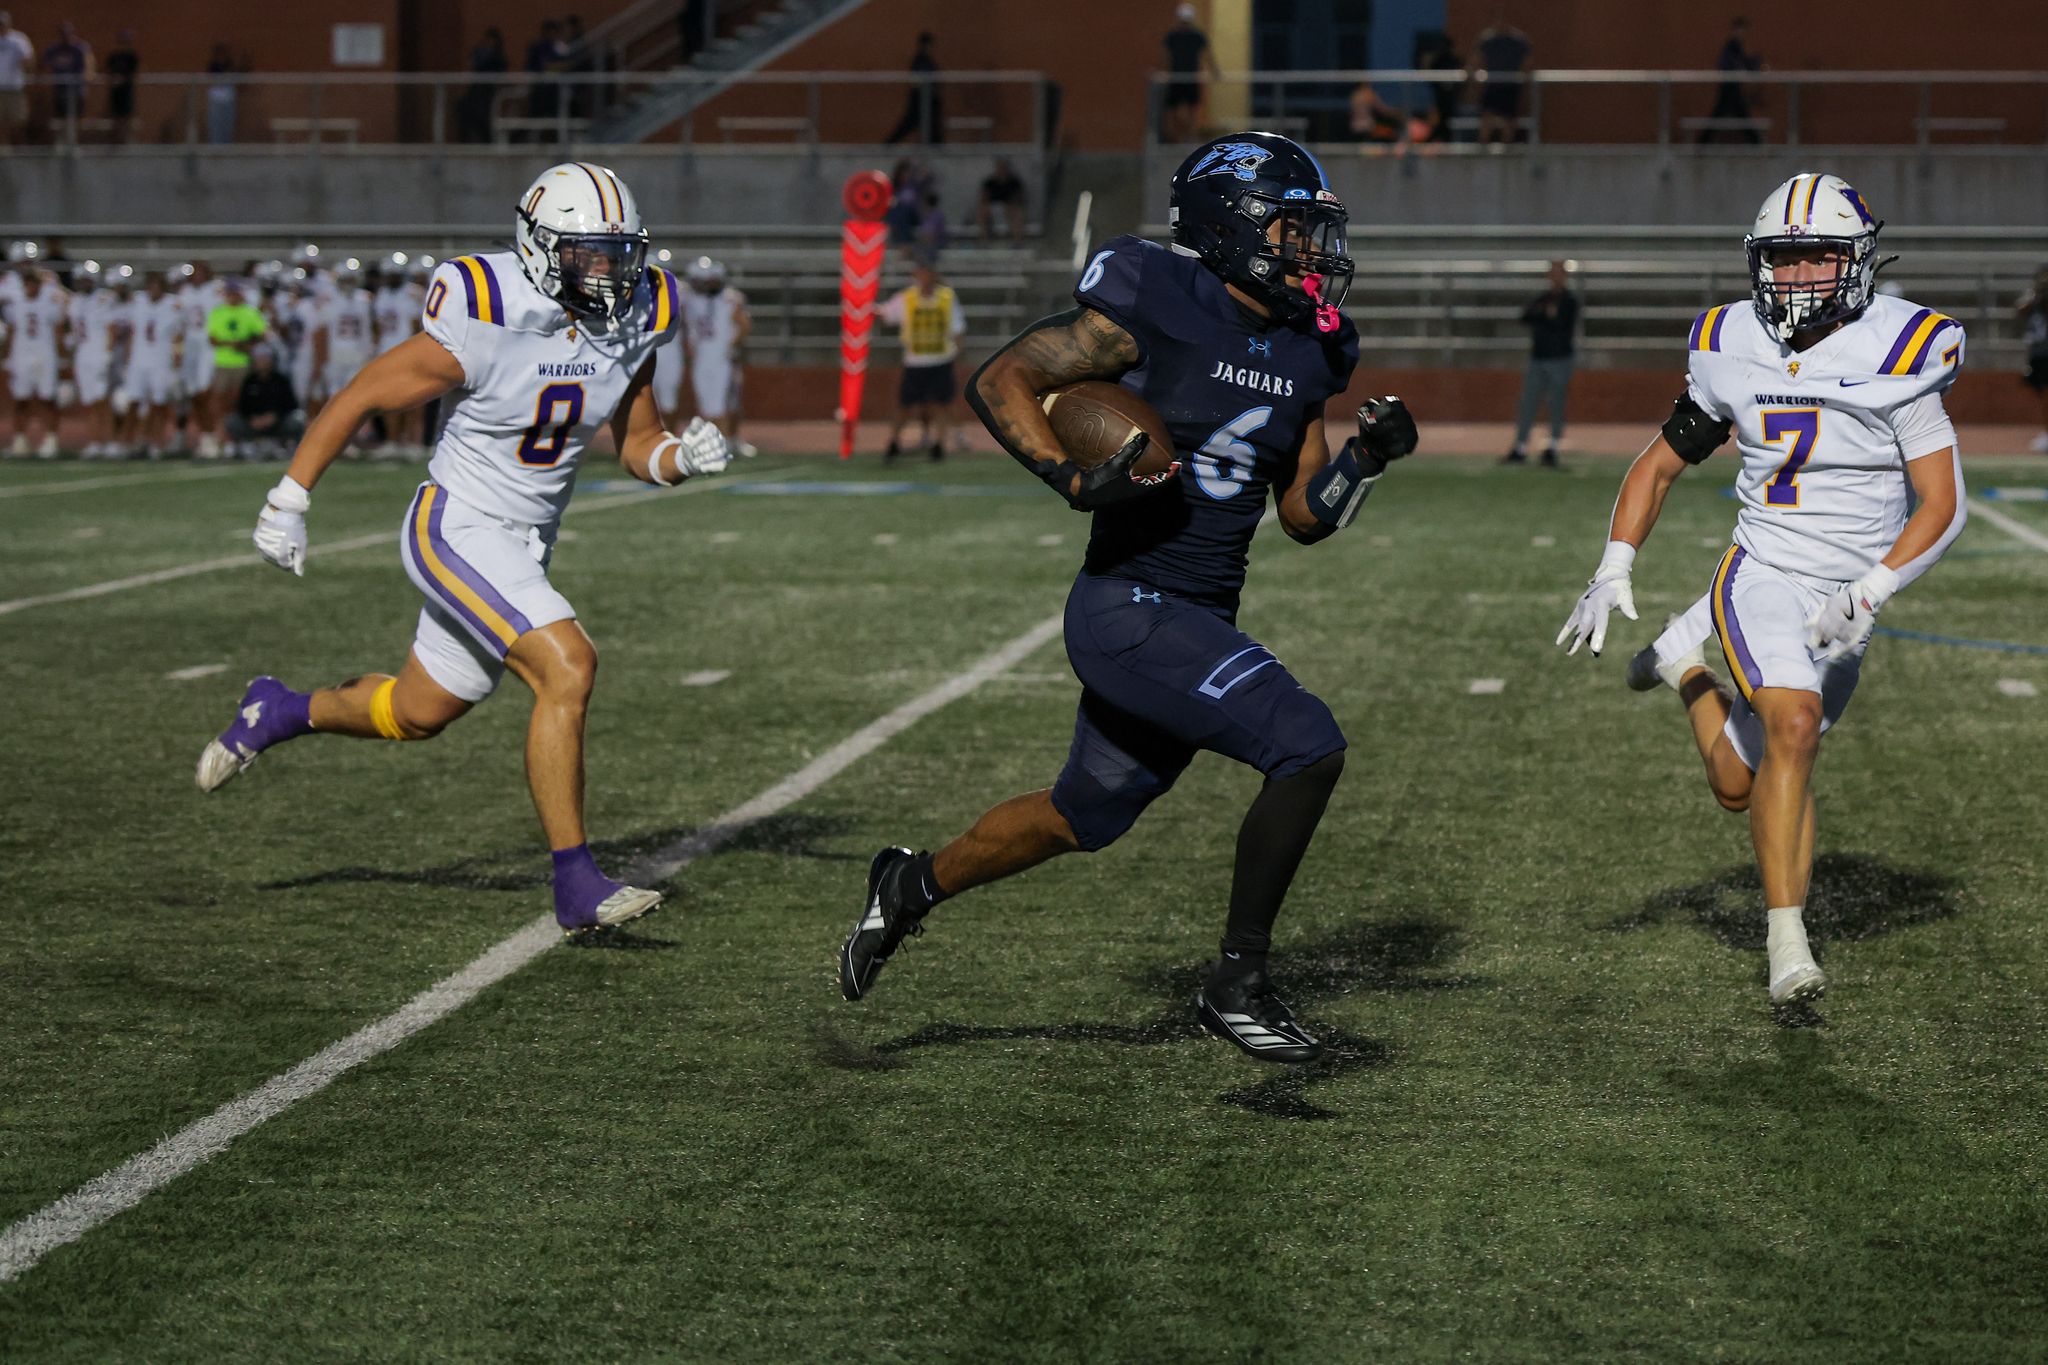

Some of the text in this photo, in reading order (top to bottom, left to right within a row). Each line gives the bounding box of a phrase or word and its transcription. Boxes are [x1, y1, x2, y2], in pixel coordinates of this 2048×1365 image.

[1078, 250, 1116, 292] 6
[426, 278, 448, 320] 0
[538, 362, 597, 377] WARRIORS
[1942, 341, 1960, 371] 7
[1209, 360, 1294, 397] JAGUARS
[1755, 394, 1826, 406] WARRIORS
[516, 381, 586, 468] 0
[1192, 406, 1273, 500] 6
[1760, 407, 1821, 508] 7
